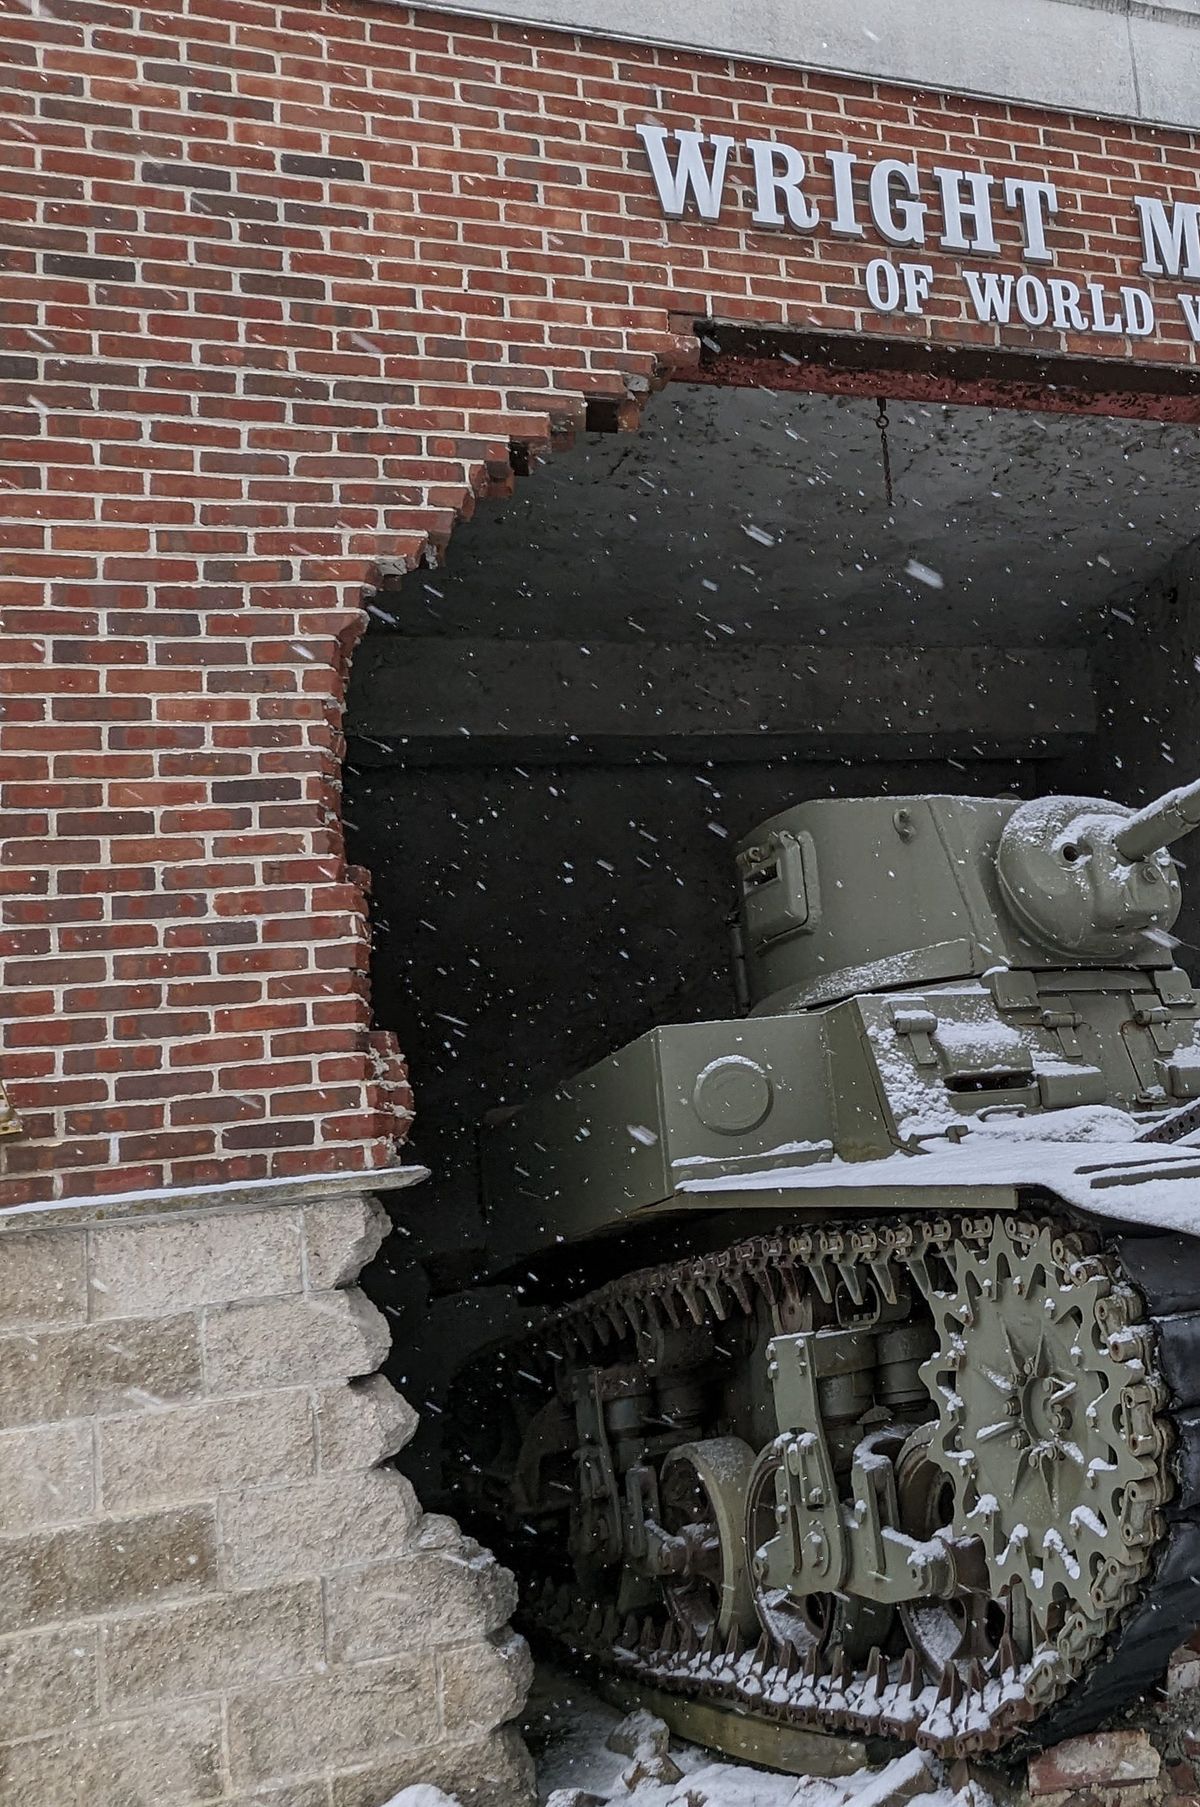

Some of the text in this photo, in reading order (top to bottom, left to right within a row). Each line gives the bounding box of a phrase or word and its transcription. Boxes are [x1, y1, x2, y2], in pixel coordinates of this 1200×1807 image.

[636, 124, 1059, 264] WRIGHT
[866, 258, 934, 315] OF
[962, 270, 1156, 337] WORLD
